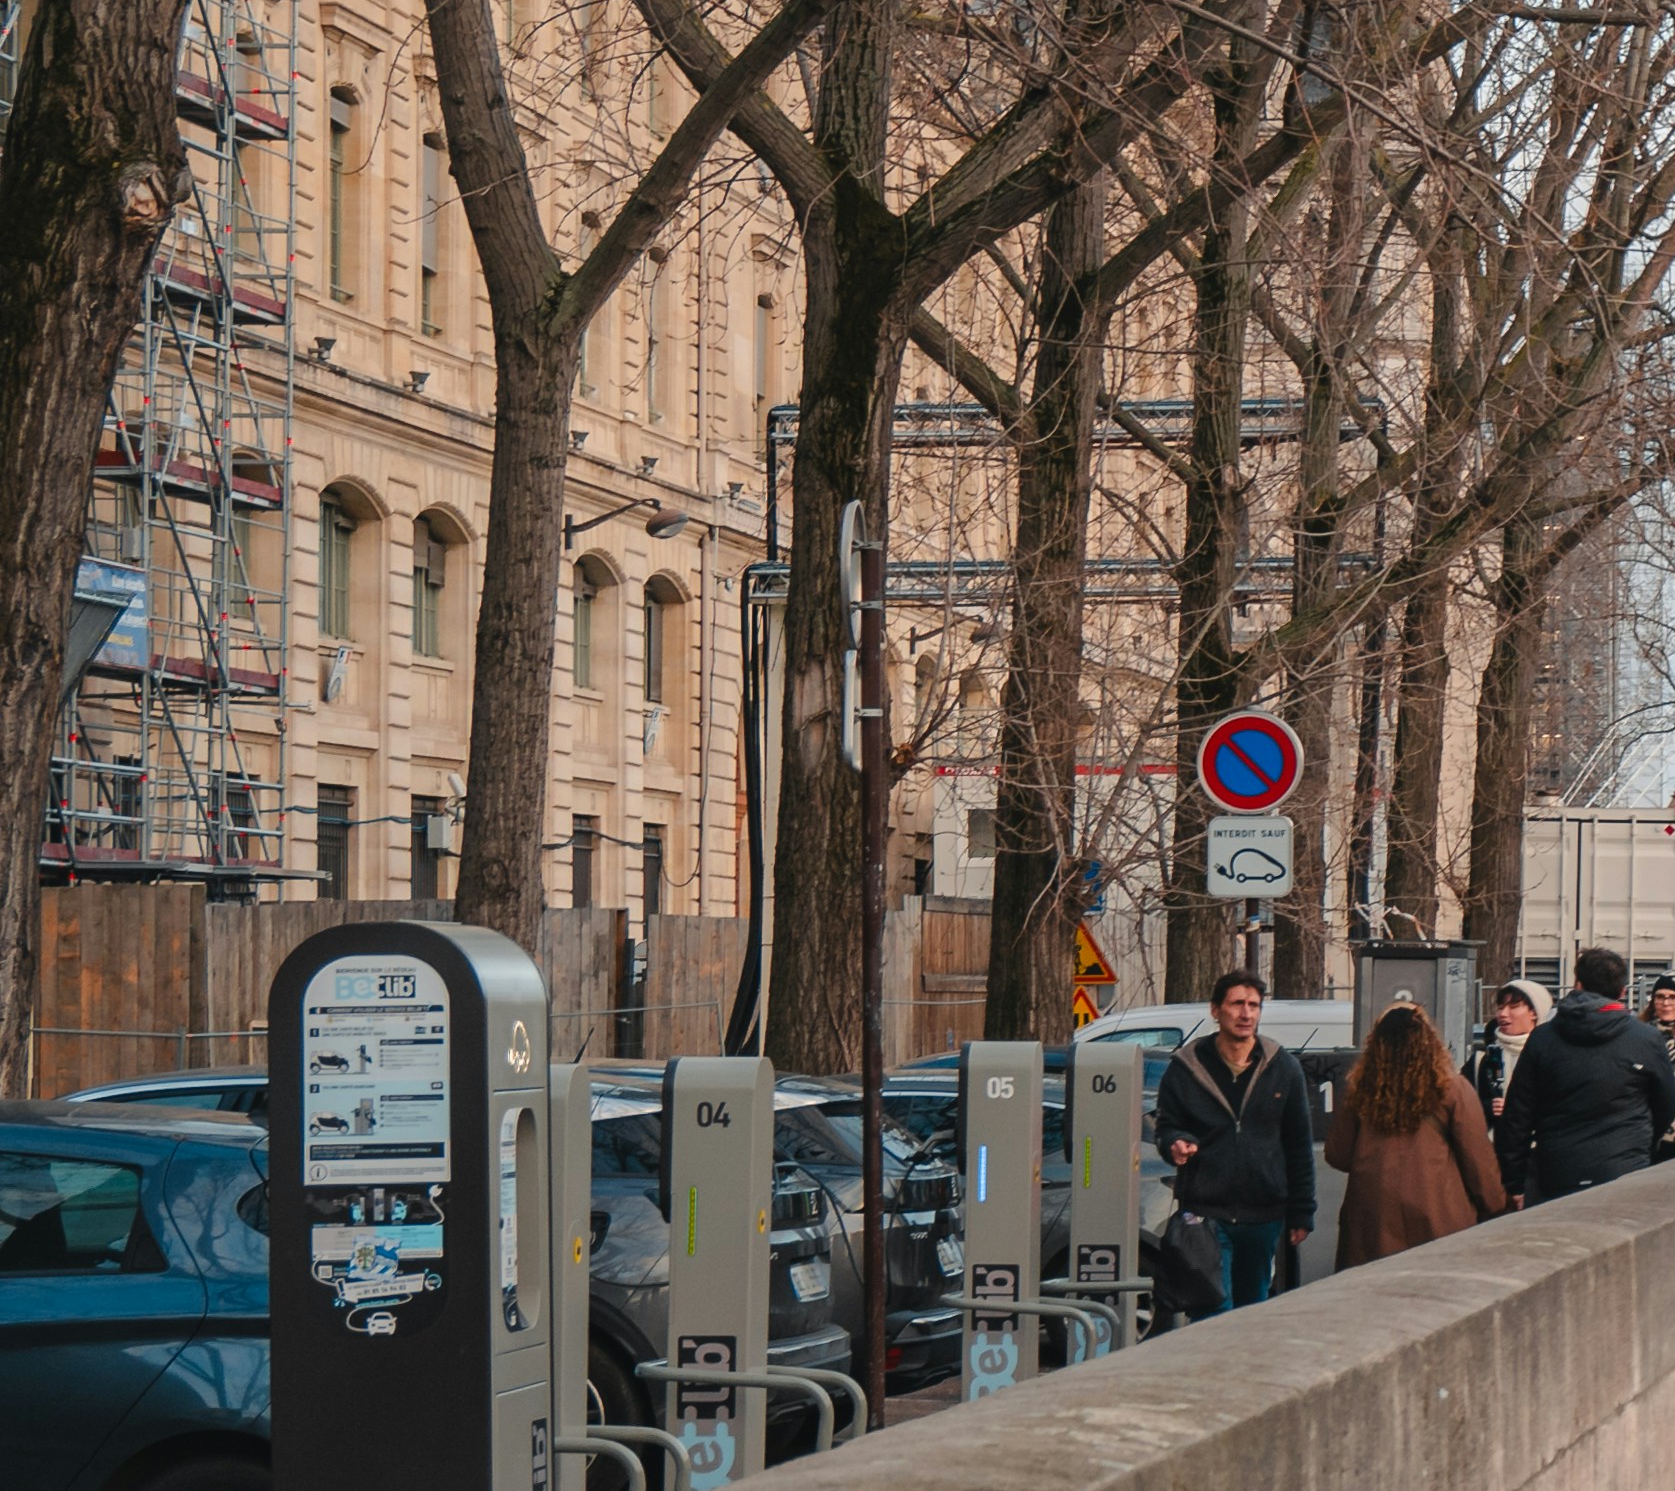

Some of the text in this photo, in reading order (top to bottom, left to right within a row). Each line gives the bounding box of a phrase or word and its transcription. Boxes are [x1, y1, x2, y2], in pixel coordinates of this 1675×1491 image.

[1213, 829, 1286, 838] INTERDIT SAUF
[986, 1076, 1015, 1099] 05
[1092, 1074, 1117, 1094] 06
[1319, 1081, 1334, 1113] 1
[696, 1101, 731, 1128] 04
